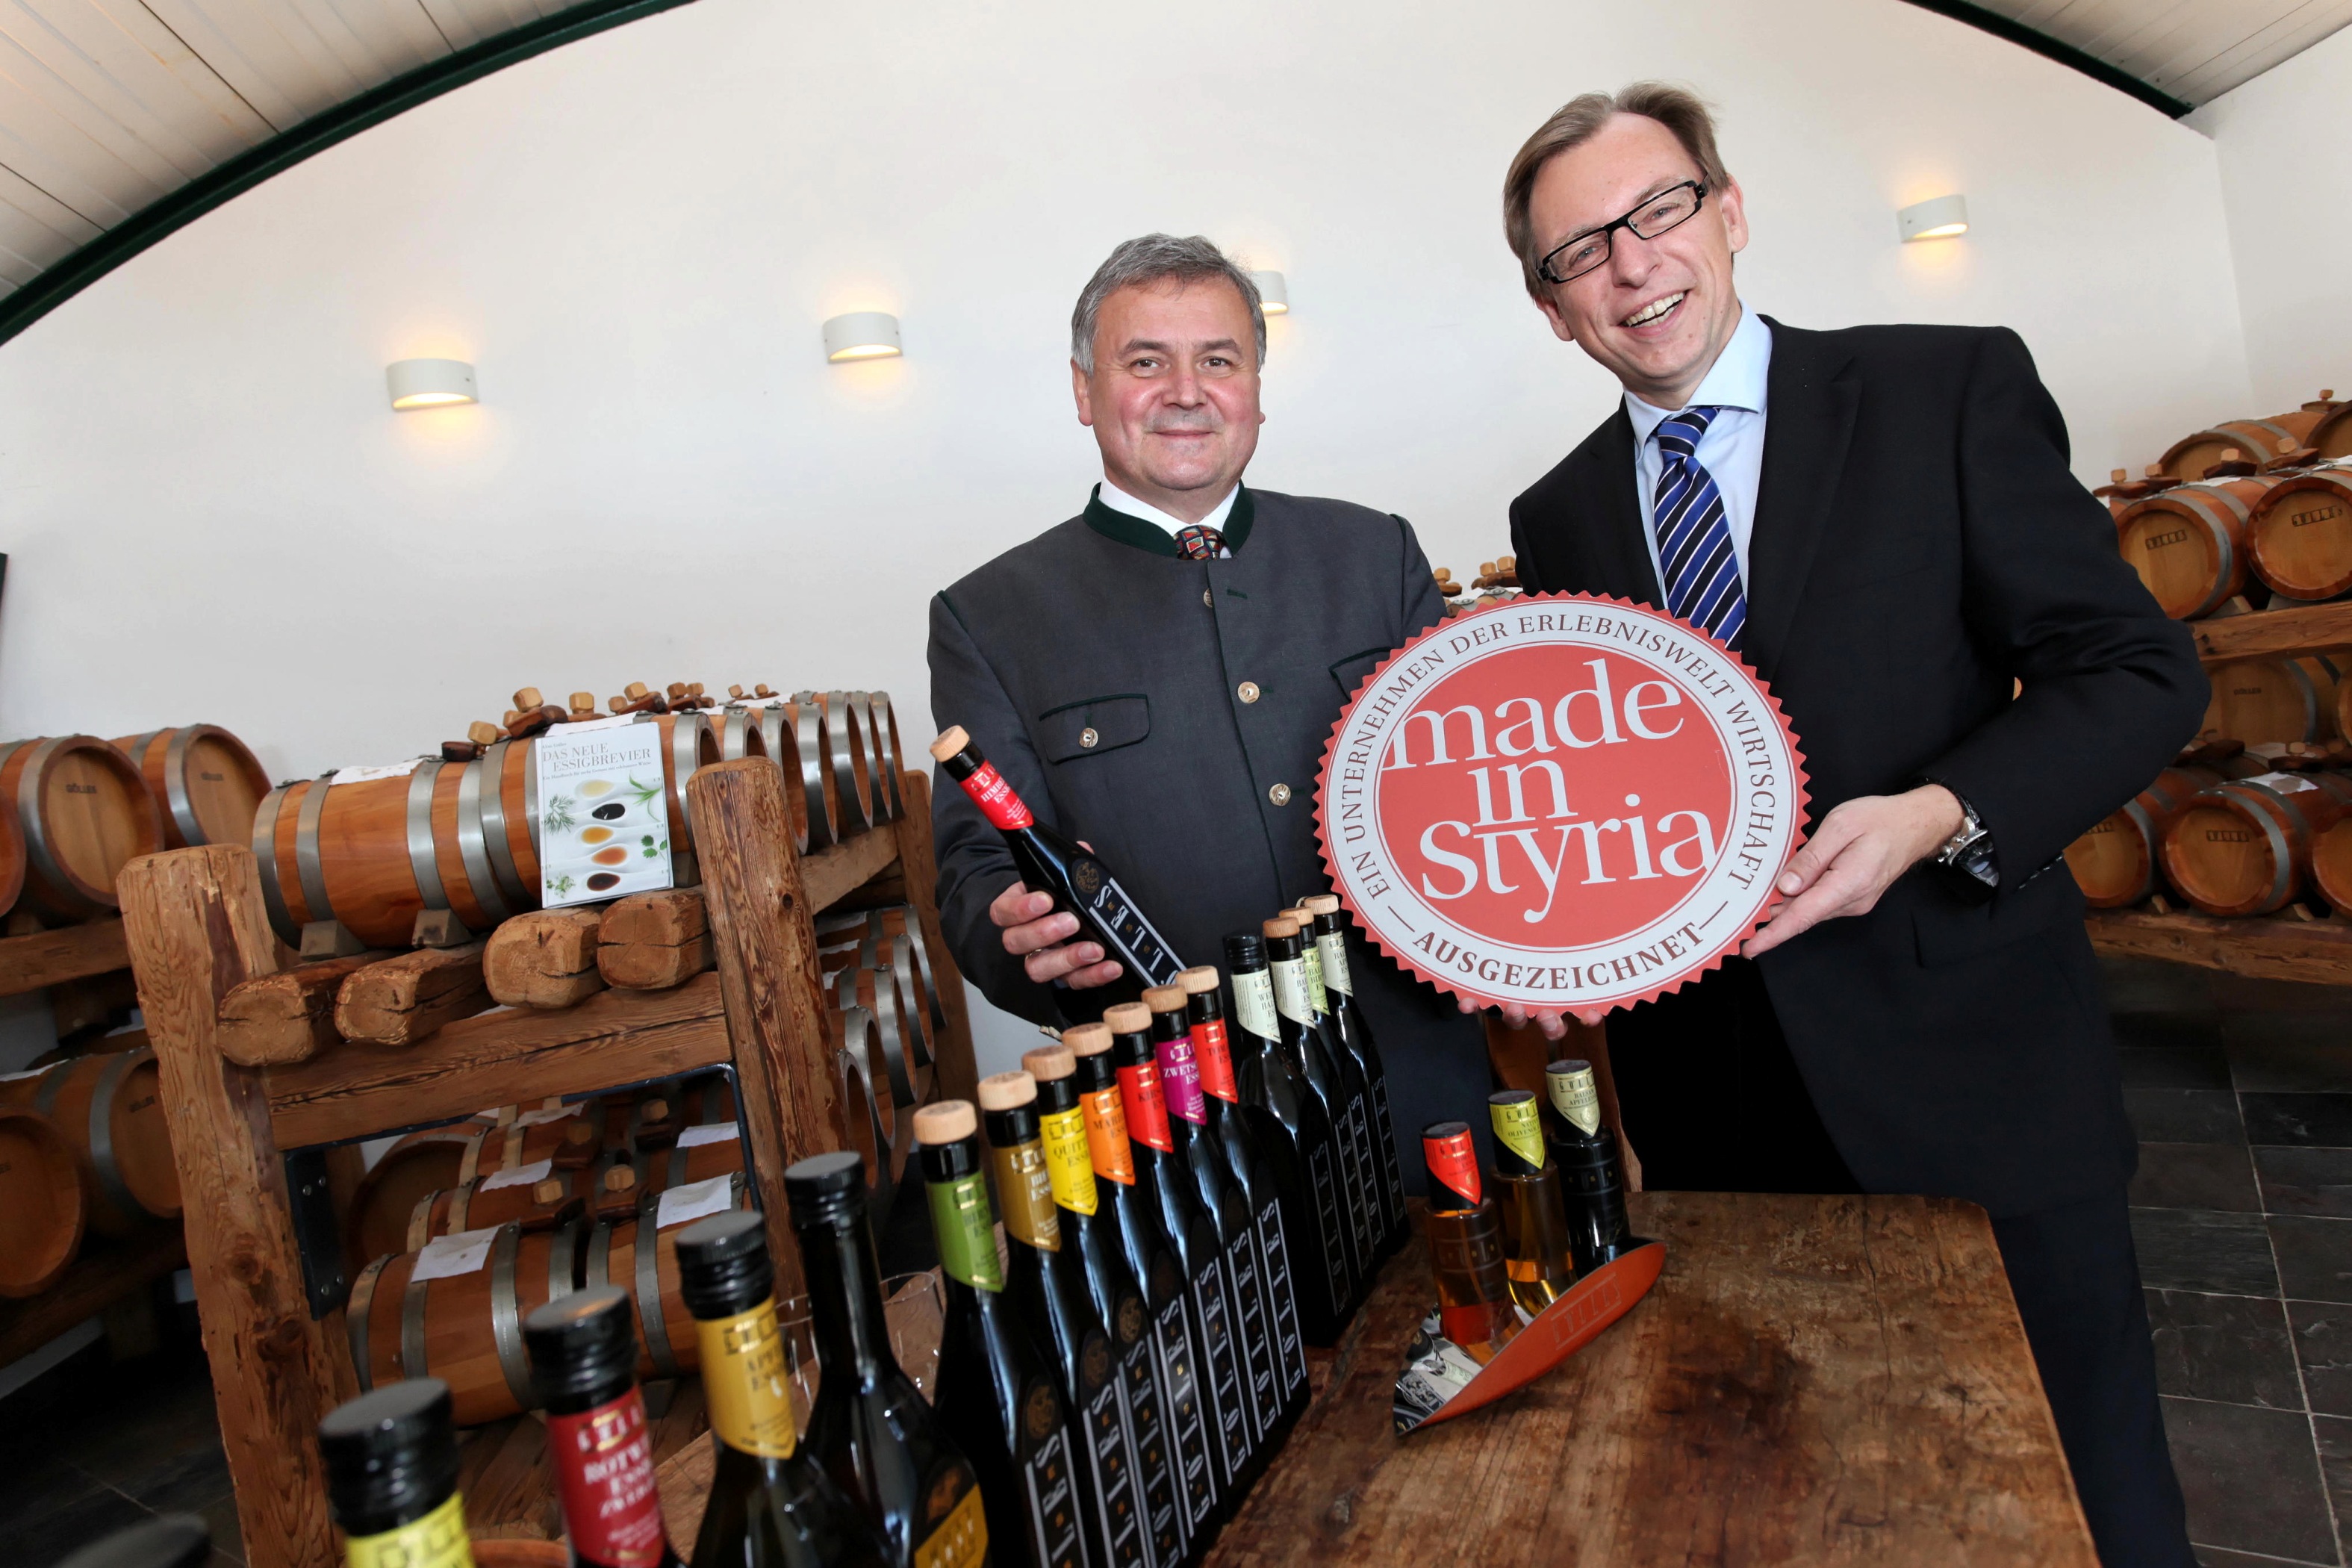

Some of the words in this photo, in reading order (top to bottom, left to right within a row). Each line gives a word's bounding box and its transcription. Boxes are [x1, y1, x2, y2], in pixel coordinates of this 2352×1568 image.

[1449, 622, 1510, 656] DER
[1518, 614, 1734, 699] ERLEBNISWELT
[1342, 648, 1446, 844] UNTERNEHMEN
[1382, 658, 1684, 771] made
[543, 748, 567, 762] DAS
[572, 742, 609, 758] NEUE
[553, 748, 651, 771] ESSIGBREVIER
[1467, 759, 1578, 827] in
[1726, 700, 1776, 892] WIRTSCHAFT
[1352, 852, 1391, 900] EIN
[1413, 922, 1703, 990] AUSGEZEICHNET
